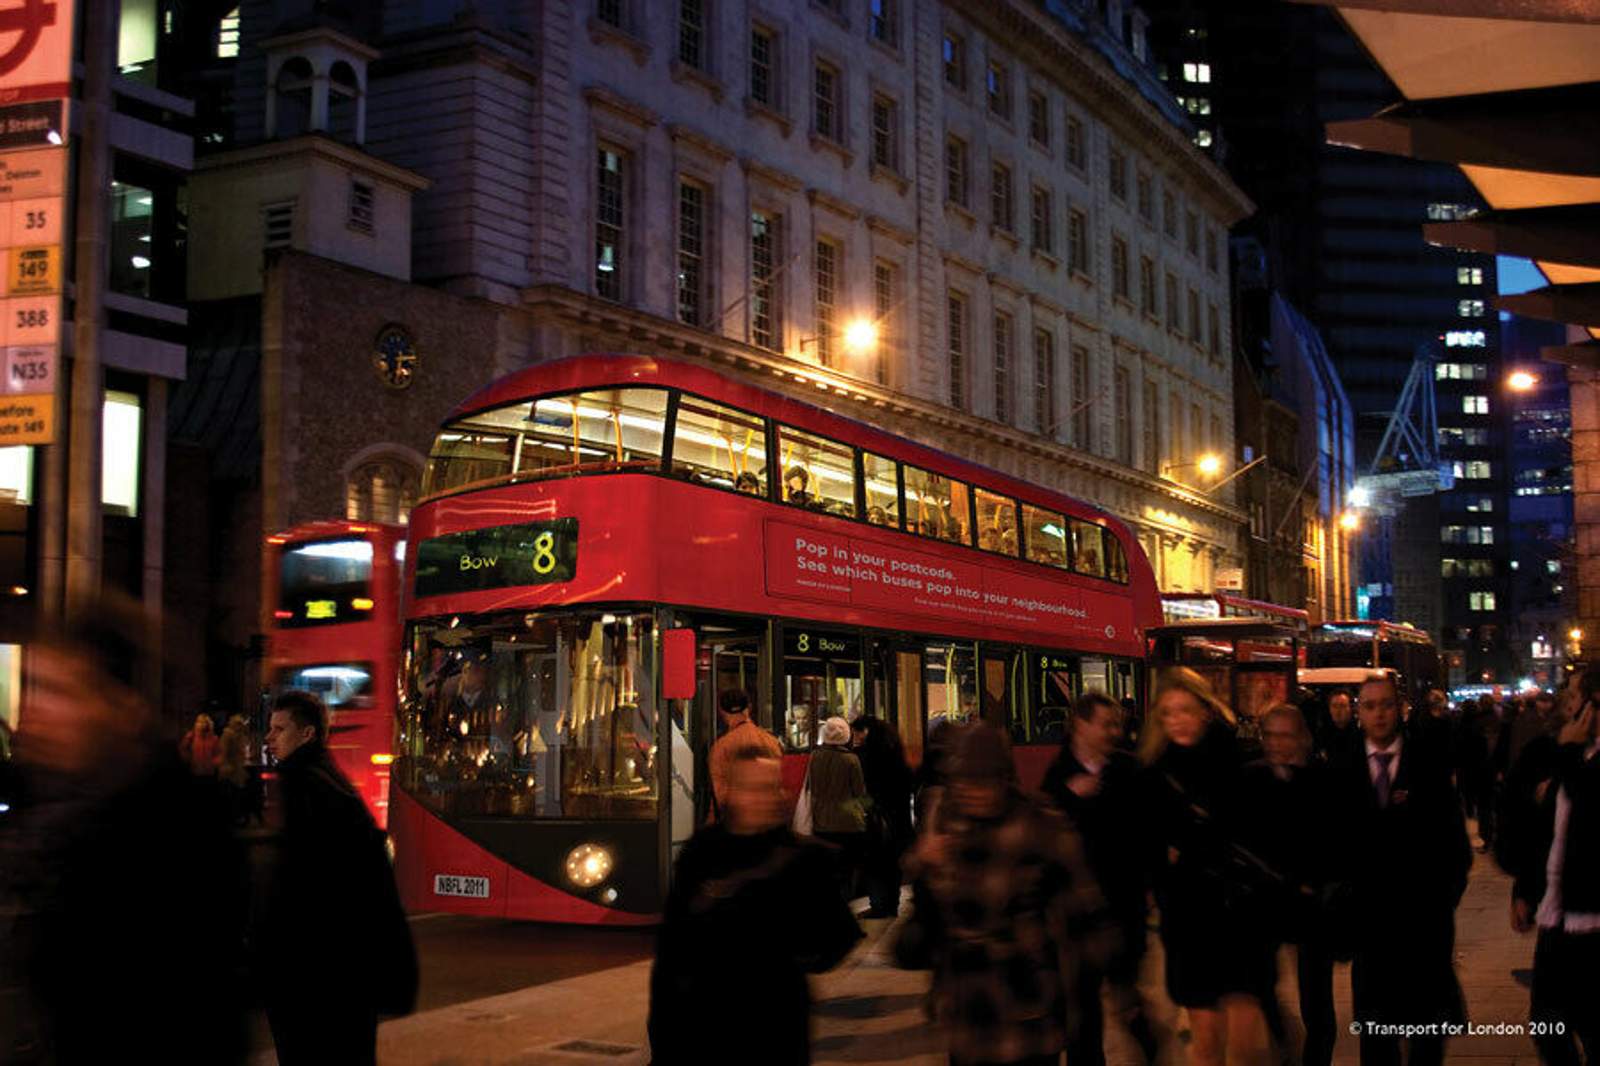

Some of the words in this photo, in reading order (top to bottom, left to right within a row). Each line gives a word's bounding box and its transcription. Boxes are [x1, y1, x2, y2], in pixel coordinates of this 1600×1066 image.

[8, 116, 49, 132] Street
[26, 211, 46, 229] 35
[19, 260, 48, 277] 149
[16, 310, 48, 328] 388
[12, 362, 48, 379] N35
[459, 554, 498, 571] Bow
[532, 532, 556, 574] 8
[796, 538, 828, 557] Pop
[833, 545, 849, 560] in
[853, 552, 886, 566] your
[891, 560, 957, 580] postcode.
[797, 556, 827, 573] See
[832, 563, 878, 582] which
[882, 572, 923, 589] buses
[927, 581, 952, 596] pop
[955, 585, 979, 600] into
[983, 593, 1009, 605] your
[798, 633, 810, 653] 8
[819, 638, 846, 651] Bow
[1041, 656, 1048, 669] 8
[438, 877, 462, 894] NBFL
[464, 878, 485, 896] 2011
